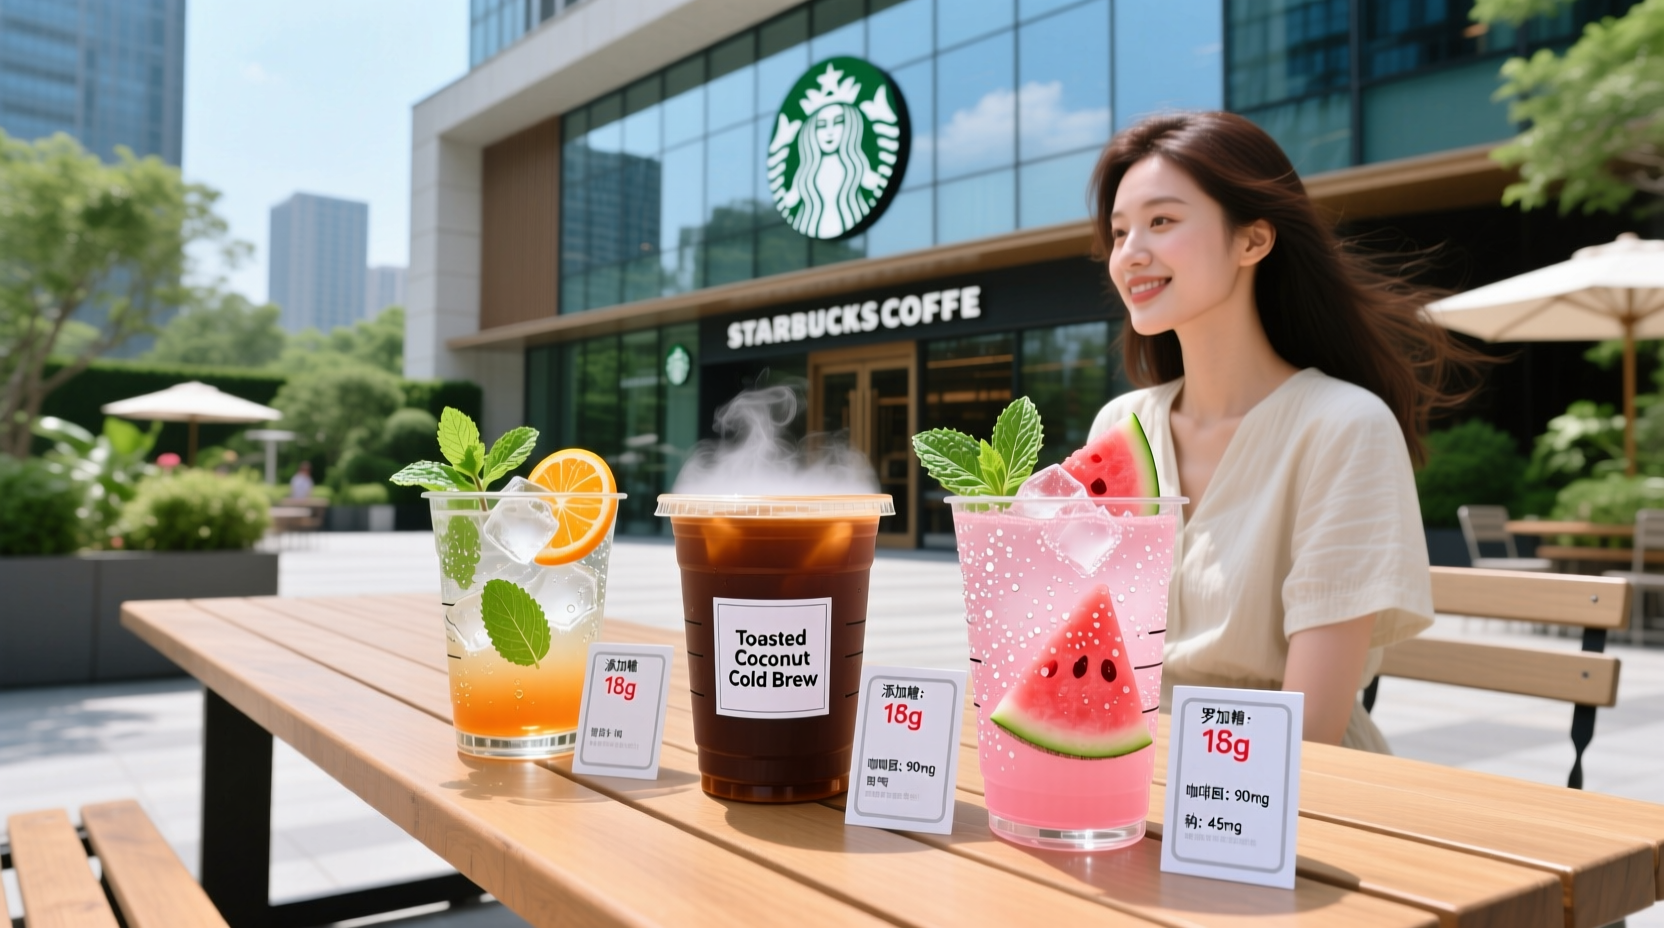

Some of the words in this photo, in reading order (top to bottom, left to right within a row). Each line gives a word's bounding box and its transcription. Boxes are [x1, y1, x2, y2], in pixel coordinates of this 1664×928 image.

[727, 300, 879, 349] STARBUCKS
[881, 285, 981, 329] COFFE
[735, 628, 807, 647] Toasted
[734, 649, 811, 667] Coconut
[604, 675, 637, 701] 18g
[728, 669, 767, 688] Cold
[772, 671, 819, 688] Brew
[884, 702, 923, 731] 18g
[1202, 728, 1251, 763] 18g
[1234, 789, 1270, 808] 90mg
[1207, 816, 1243, 836] 45mg
